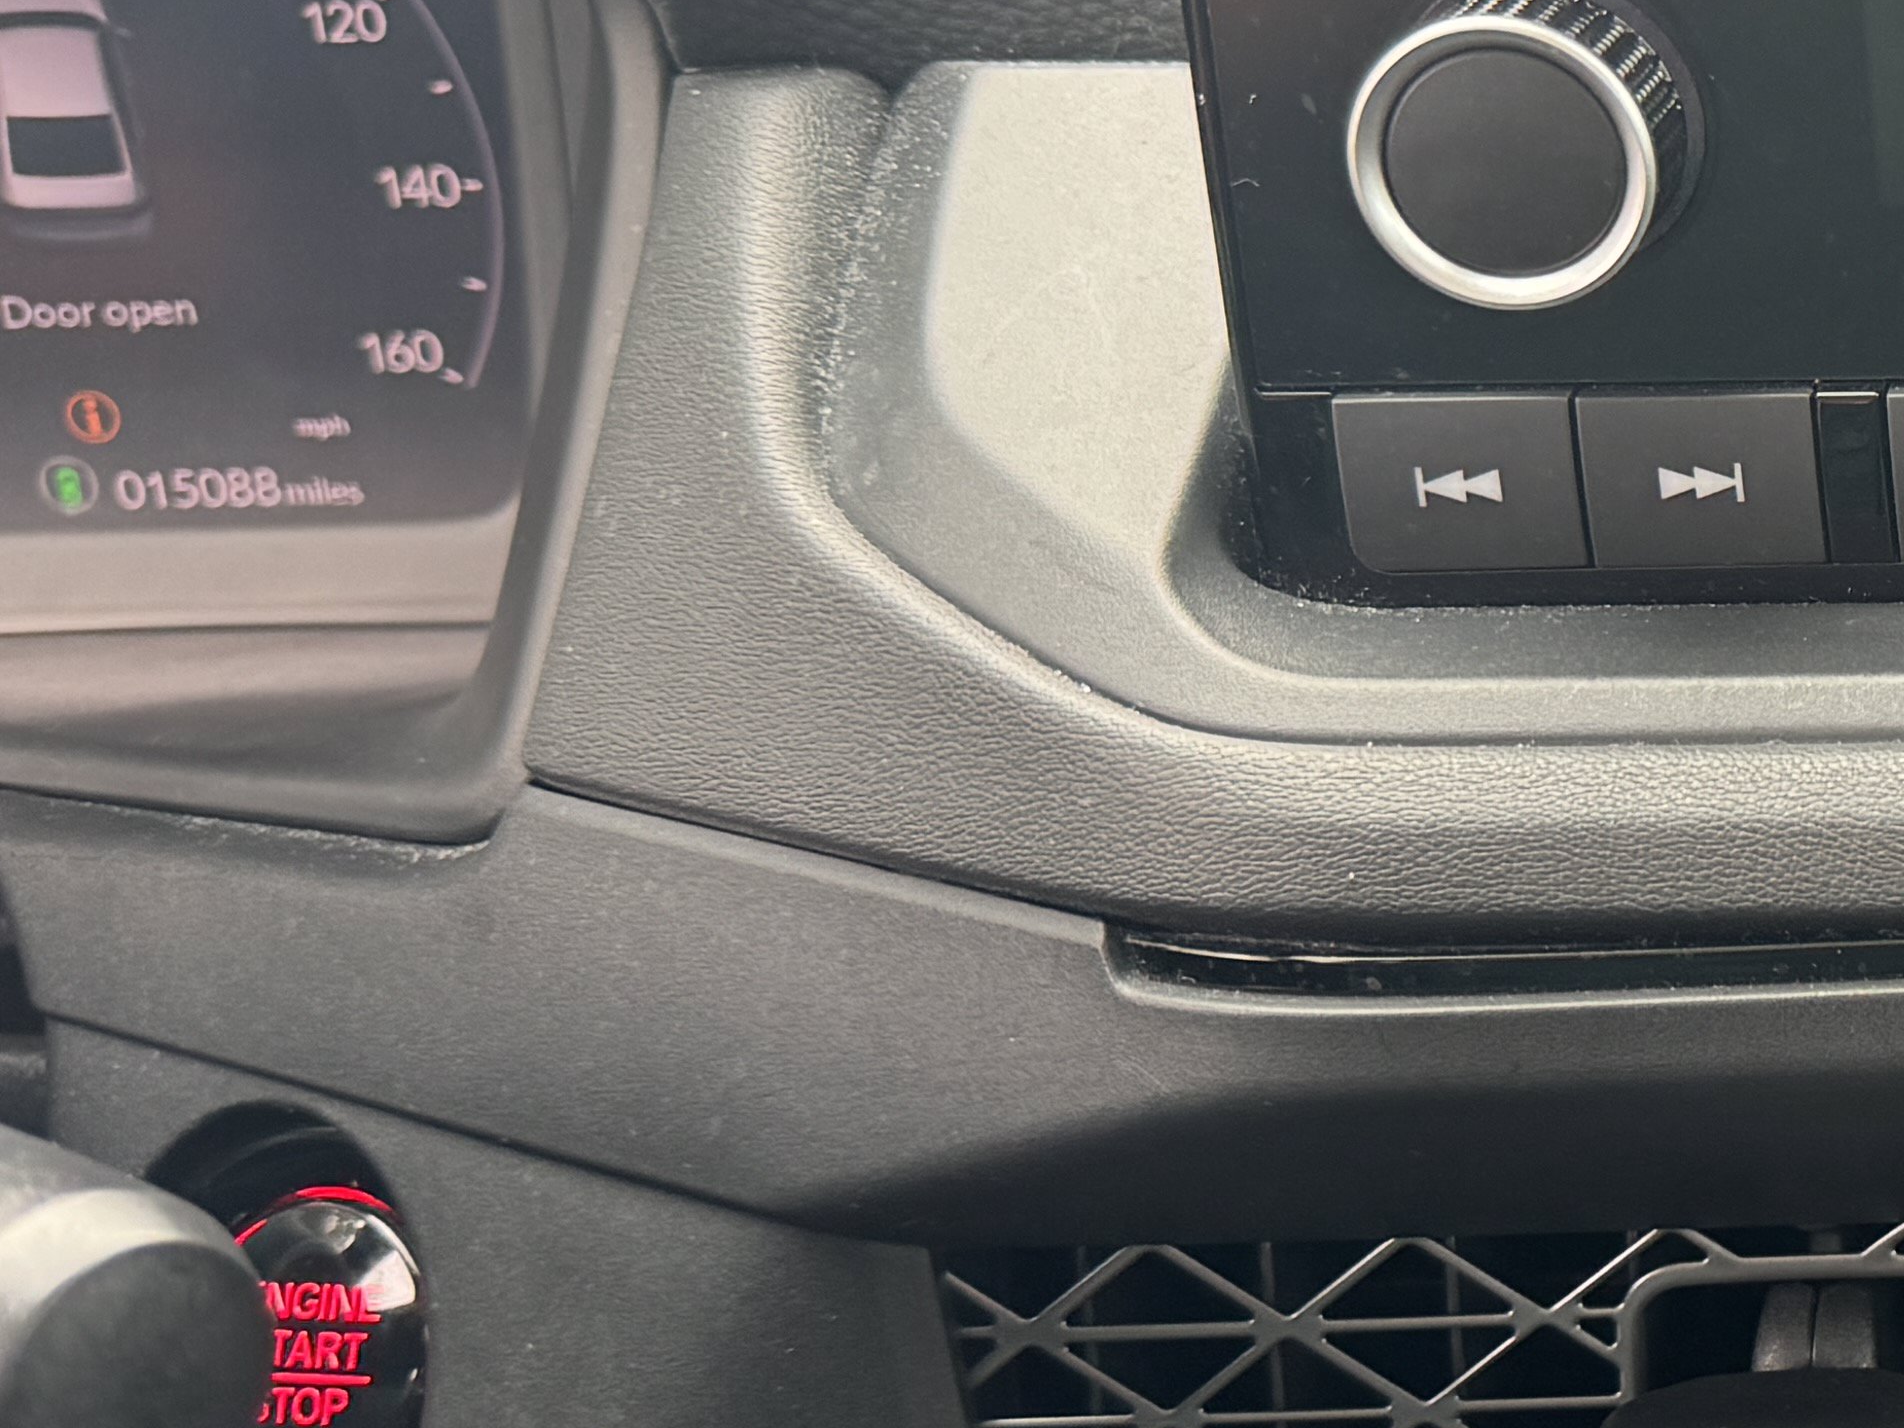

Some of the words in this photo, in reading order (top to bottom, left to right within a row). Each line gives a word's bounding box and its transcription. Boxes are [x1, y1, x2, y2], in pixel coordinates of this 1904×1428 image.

[374, 163, 462, 209] 140
[0, 294, 96, 330] Door
[101, 298, 200, 334] open
[357, 328, 444, 375] 160
[291, 413, 352, 442] mph
[113, 465, 283, 512] 015088
[283, 475, 366, 507] miles
[259, 1280, 382, 1323] NGINE
[272, 1328, 369, 1371] TART
